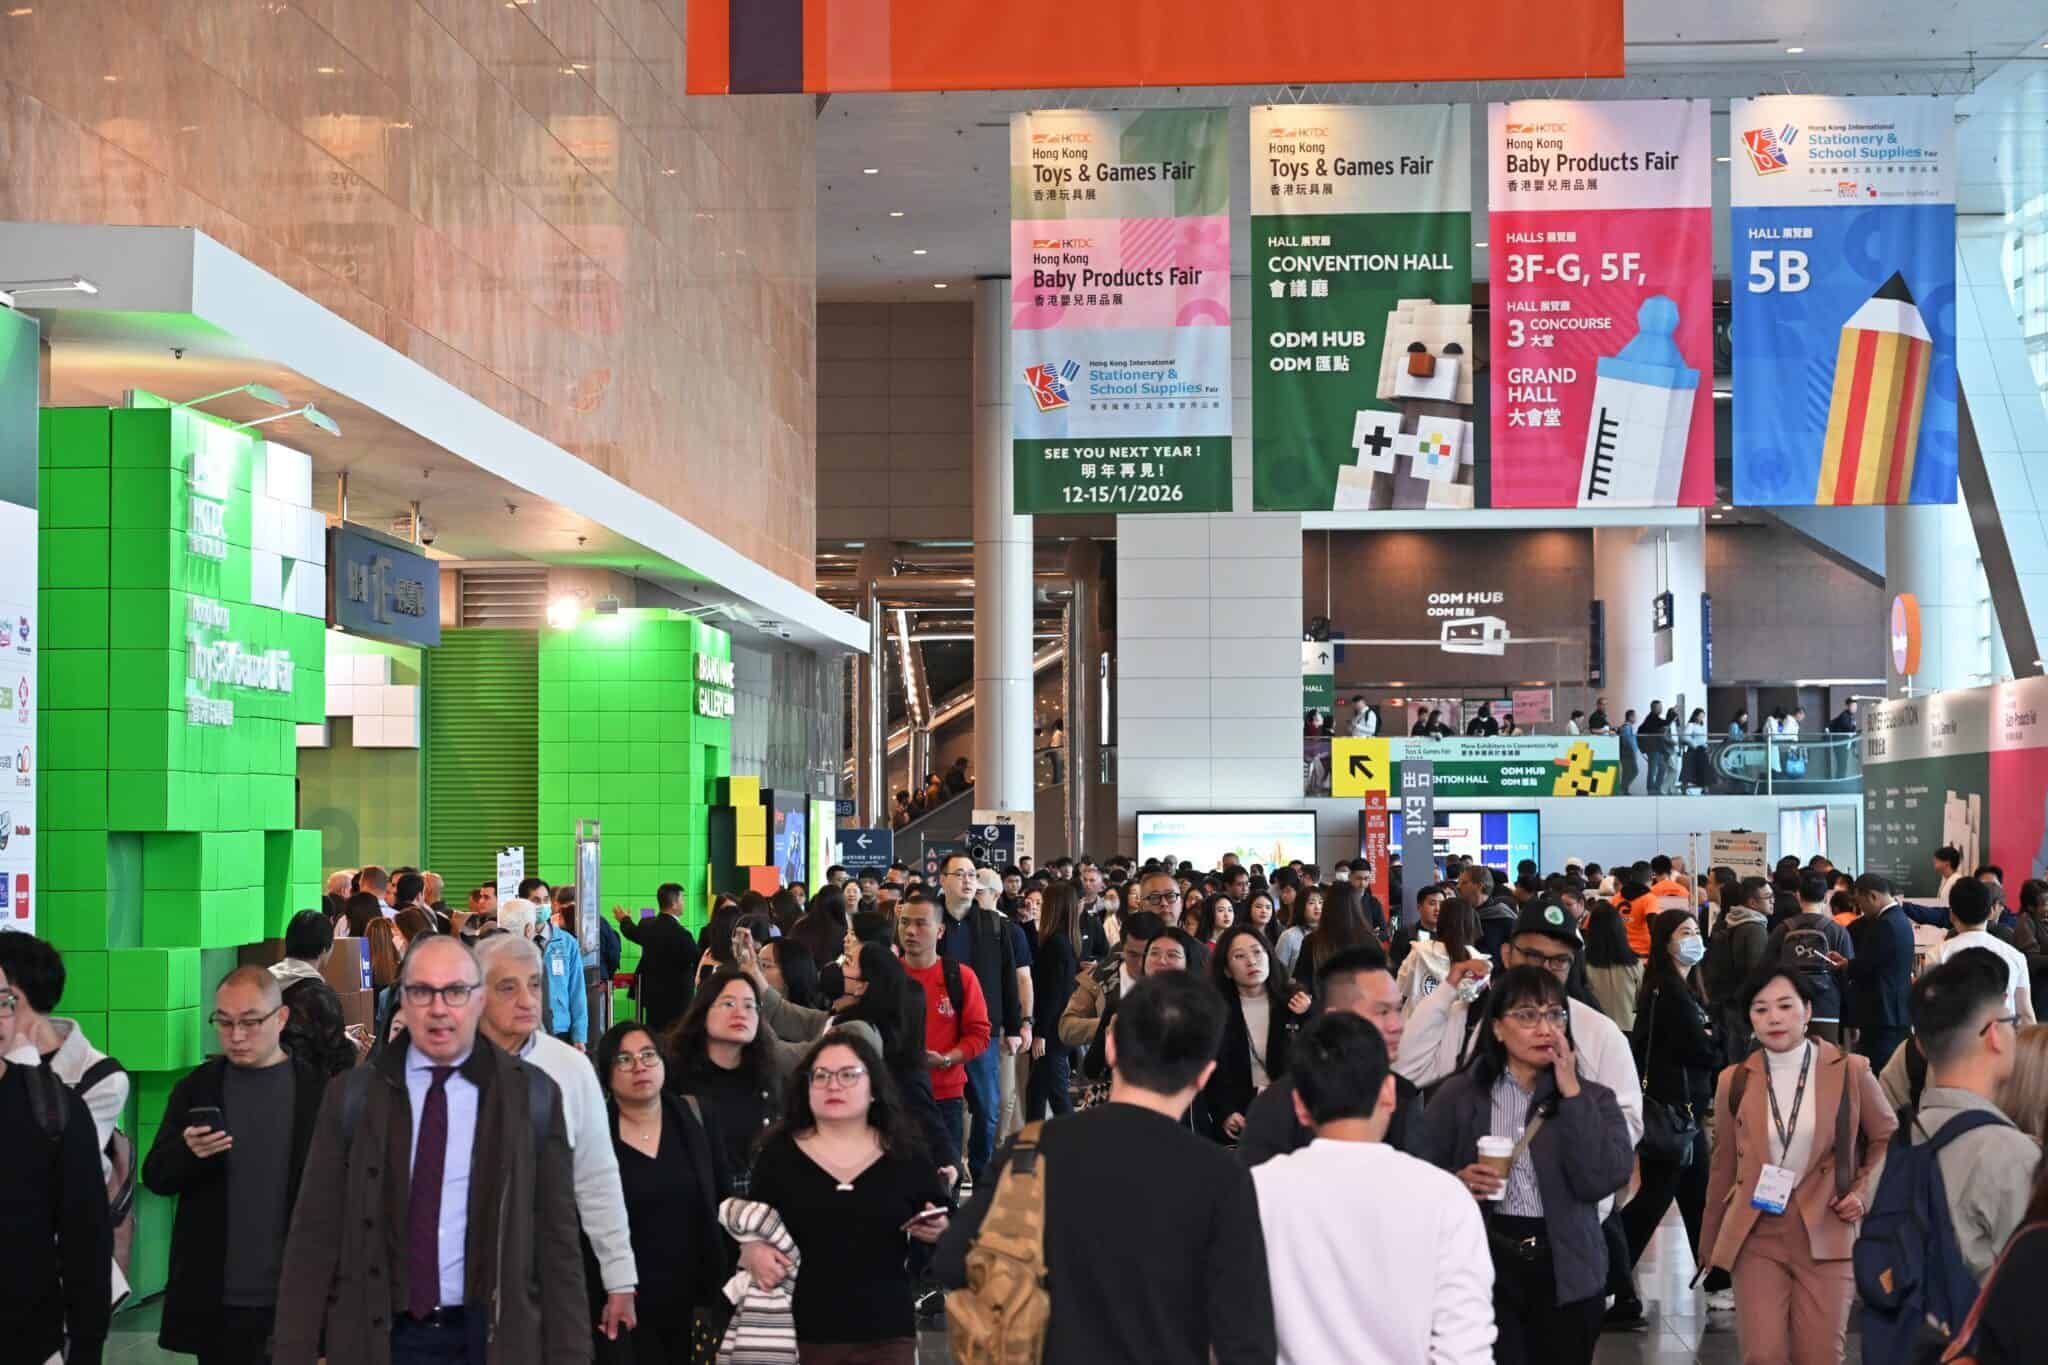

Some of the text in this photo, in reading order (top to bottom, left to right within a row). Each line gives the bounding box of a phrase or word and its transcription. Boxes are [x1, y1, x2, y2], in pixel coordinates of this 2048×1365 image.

[1506, 138, 1563, 151] Hong Kong
[1808, 133, 1897, 146] Stationery &
[1033, 148, 1088, 160] Hong Kong
[1269, 142, 1325, 155] Hong Kong
[1808, 147, 1856, 159] School
[1860, 146, 1921, 159] Supplies
[1270, 156, 1434, 181] Toys & Games Fair
[1507, 152, 1679, 176] Baby Products Fair
[1033, 161, 1195, 187] Toys & Games Fair
[1270, 184, 1333, 196] 香港玩具展
[1508, 179, 1598, 192] 香港嬰兒用品展
[1034, 188, 1096, 200] 香港玩具展
[1506, 232, 1544, 243] HALLS
[1749, 228, 1781, 239] HALL
[1268, 236, 1299, 247] HALL
[1033, 253, 1089, 266] Hong Kong
[1268, 253, 1454, 272] CONVENTION HALL
[1506, 252, 1646, 287] 3F-G, 5F,
[1748, 250, 1811, 293] 5B
[1033, 266, 1202, 291] Baby Products Fair
[1034, 293, 1123, 306] 香港嬰兒用品展
[1507, 302, 1537, 312] HALL
[1507, 318, 1612, 347] 3 CONCOURSE
[1270, 331, 1365, 348] ODM HUB
[1531, 334, 1555, 347] 大堂
[1270, 358, 1311, 372] ODM
[1089, 369, 1178, 381] Stationery &
[1508, 368, 1577, 383] GRAND
[1089, 383, 1138, 395] School
[1141, 382, 1202, 395] Supplies
[1508, 387, 1557, 402] HALL
[1508, 408, 1561, 427] 大會堂
[1044, 448, 1069, 459] SEE
[1074, 447, 1105, 458] YOU
[1109, 447, 1149, 458] NEXT
[1063, 485, 1183, 503] 12-15/1/2026
[1428, 592, 1504, 604] ODM HUB
[1426, 607, 1454, 616] ODM
[1501, 767, 1546, 775] ODM HUB
[1403, 771, 1430, 788] 出口
[1466, 775, 1488, 784] HALL
[1406, 796, 1427, 836] Exit
